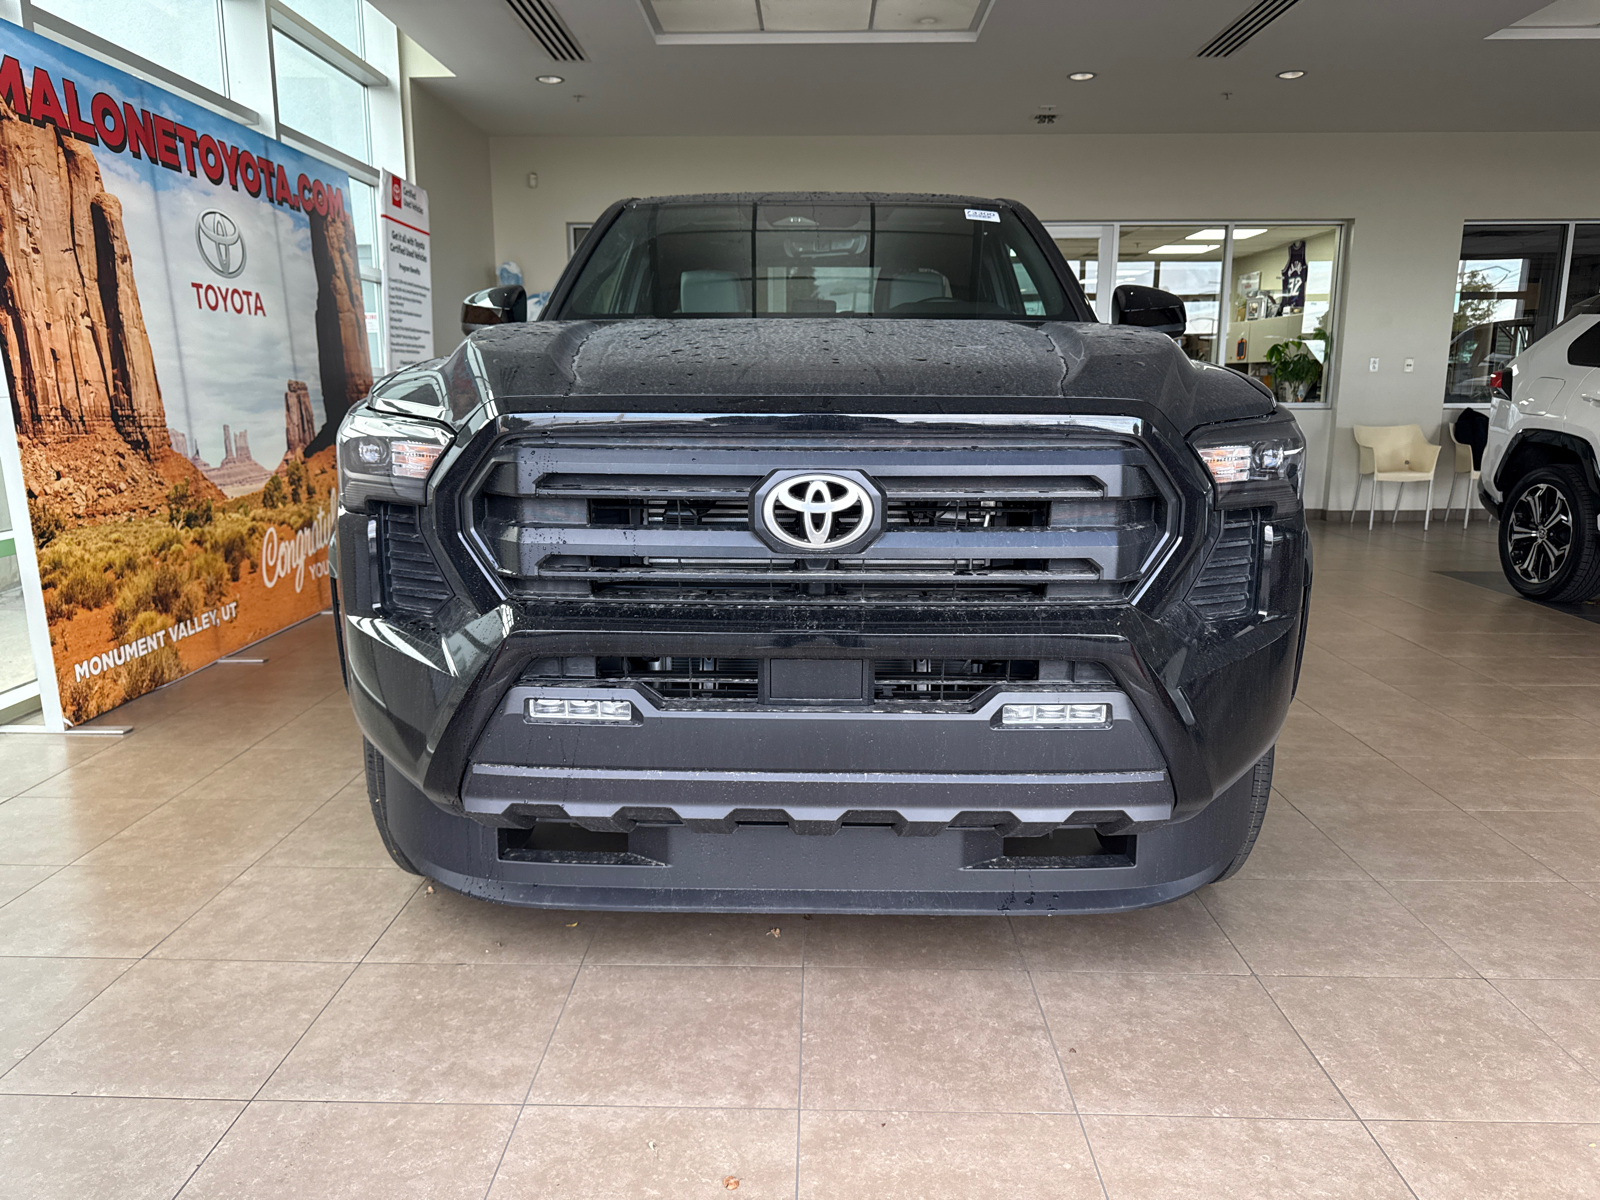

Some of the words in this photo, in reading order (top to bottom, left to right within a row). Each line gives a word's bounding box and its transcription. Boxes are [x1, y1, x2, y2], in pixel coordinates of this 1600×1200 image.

[191, 282, 267, 317] TOYOTA
[74, 629, 166, 683] MONUMENT
[168, 609, 220, 643] VALLEY,
[221, 601, 238, 622] UT
